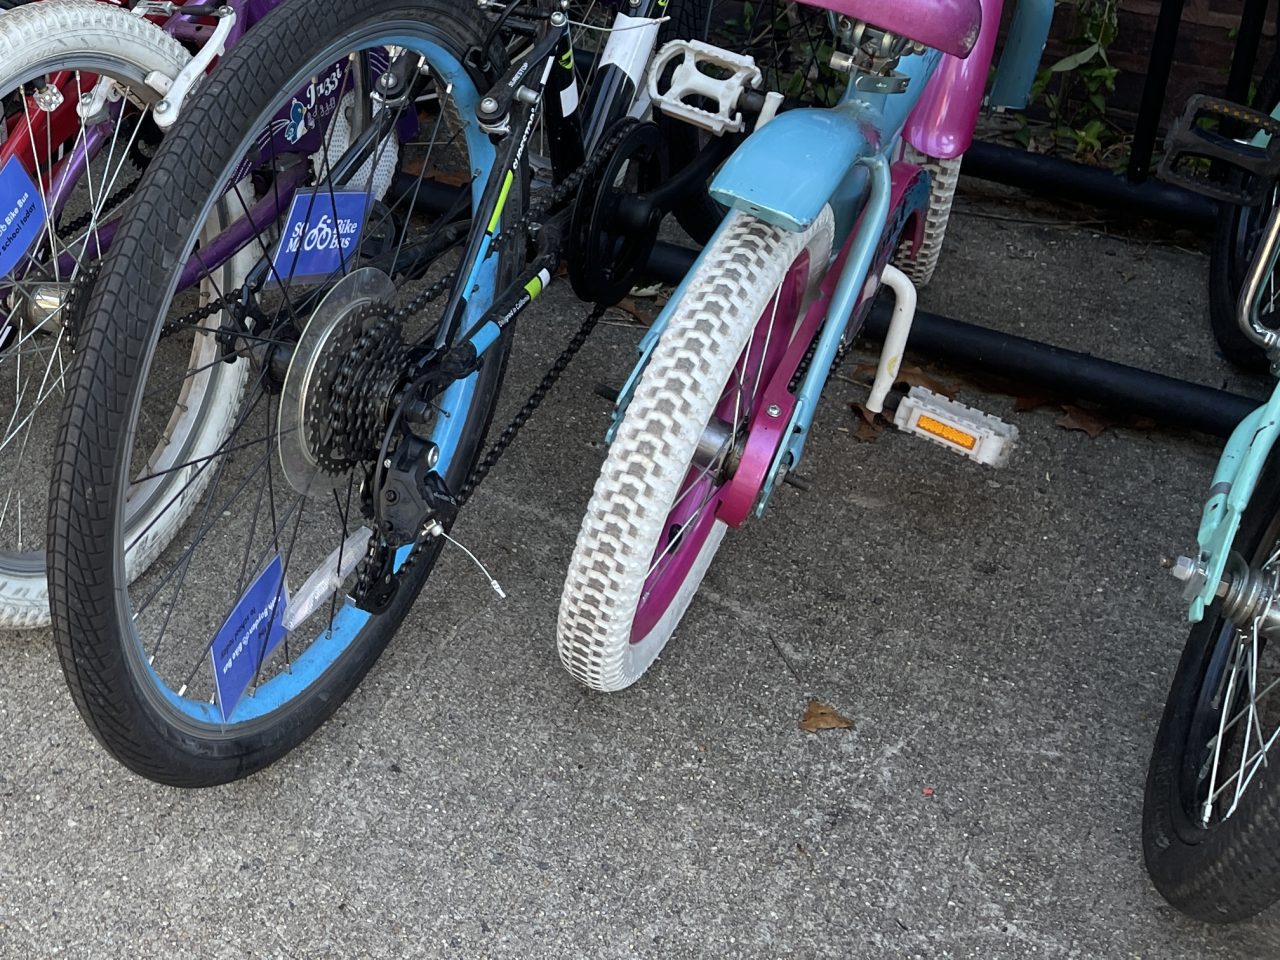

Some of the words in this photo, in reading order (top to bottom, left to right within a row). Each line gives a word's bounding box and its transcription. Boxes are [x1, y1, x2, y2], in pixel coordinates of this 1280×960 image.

[4, 207, 20, 227] Bike
[17, 192, 29, 208] Bus
[333, 218, 358, 235] Bike
[1, 225, 22, 252] school
[19, 203, 36, 226] today
